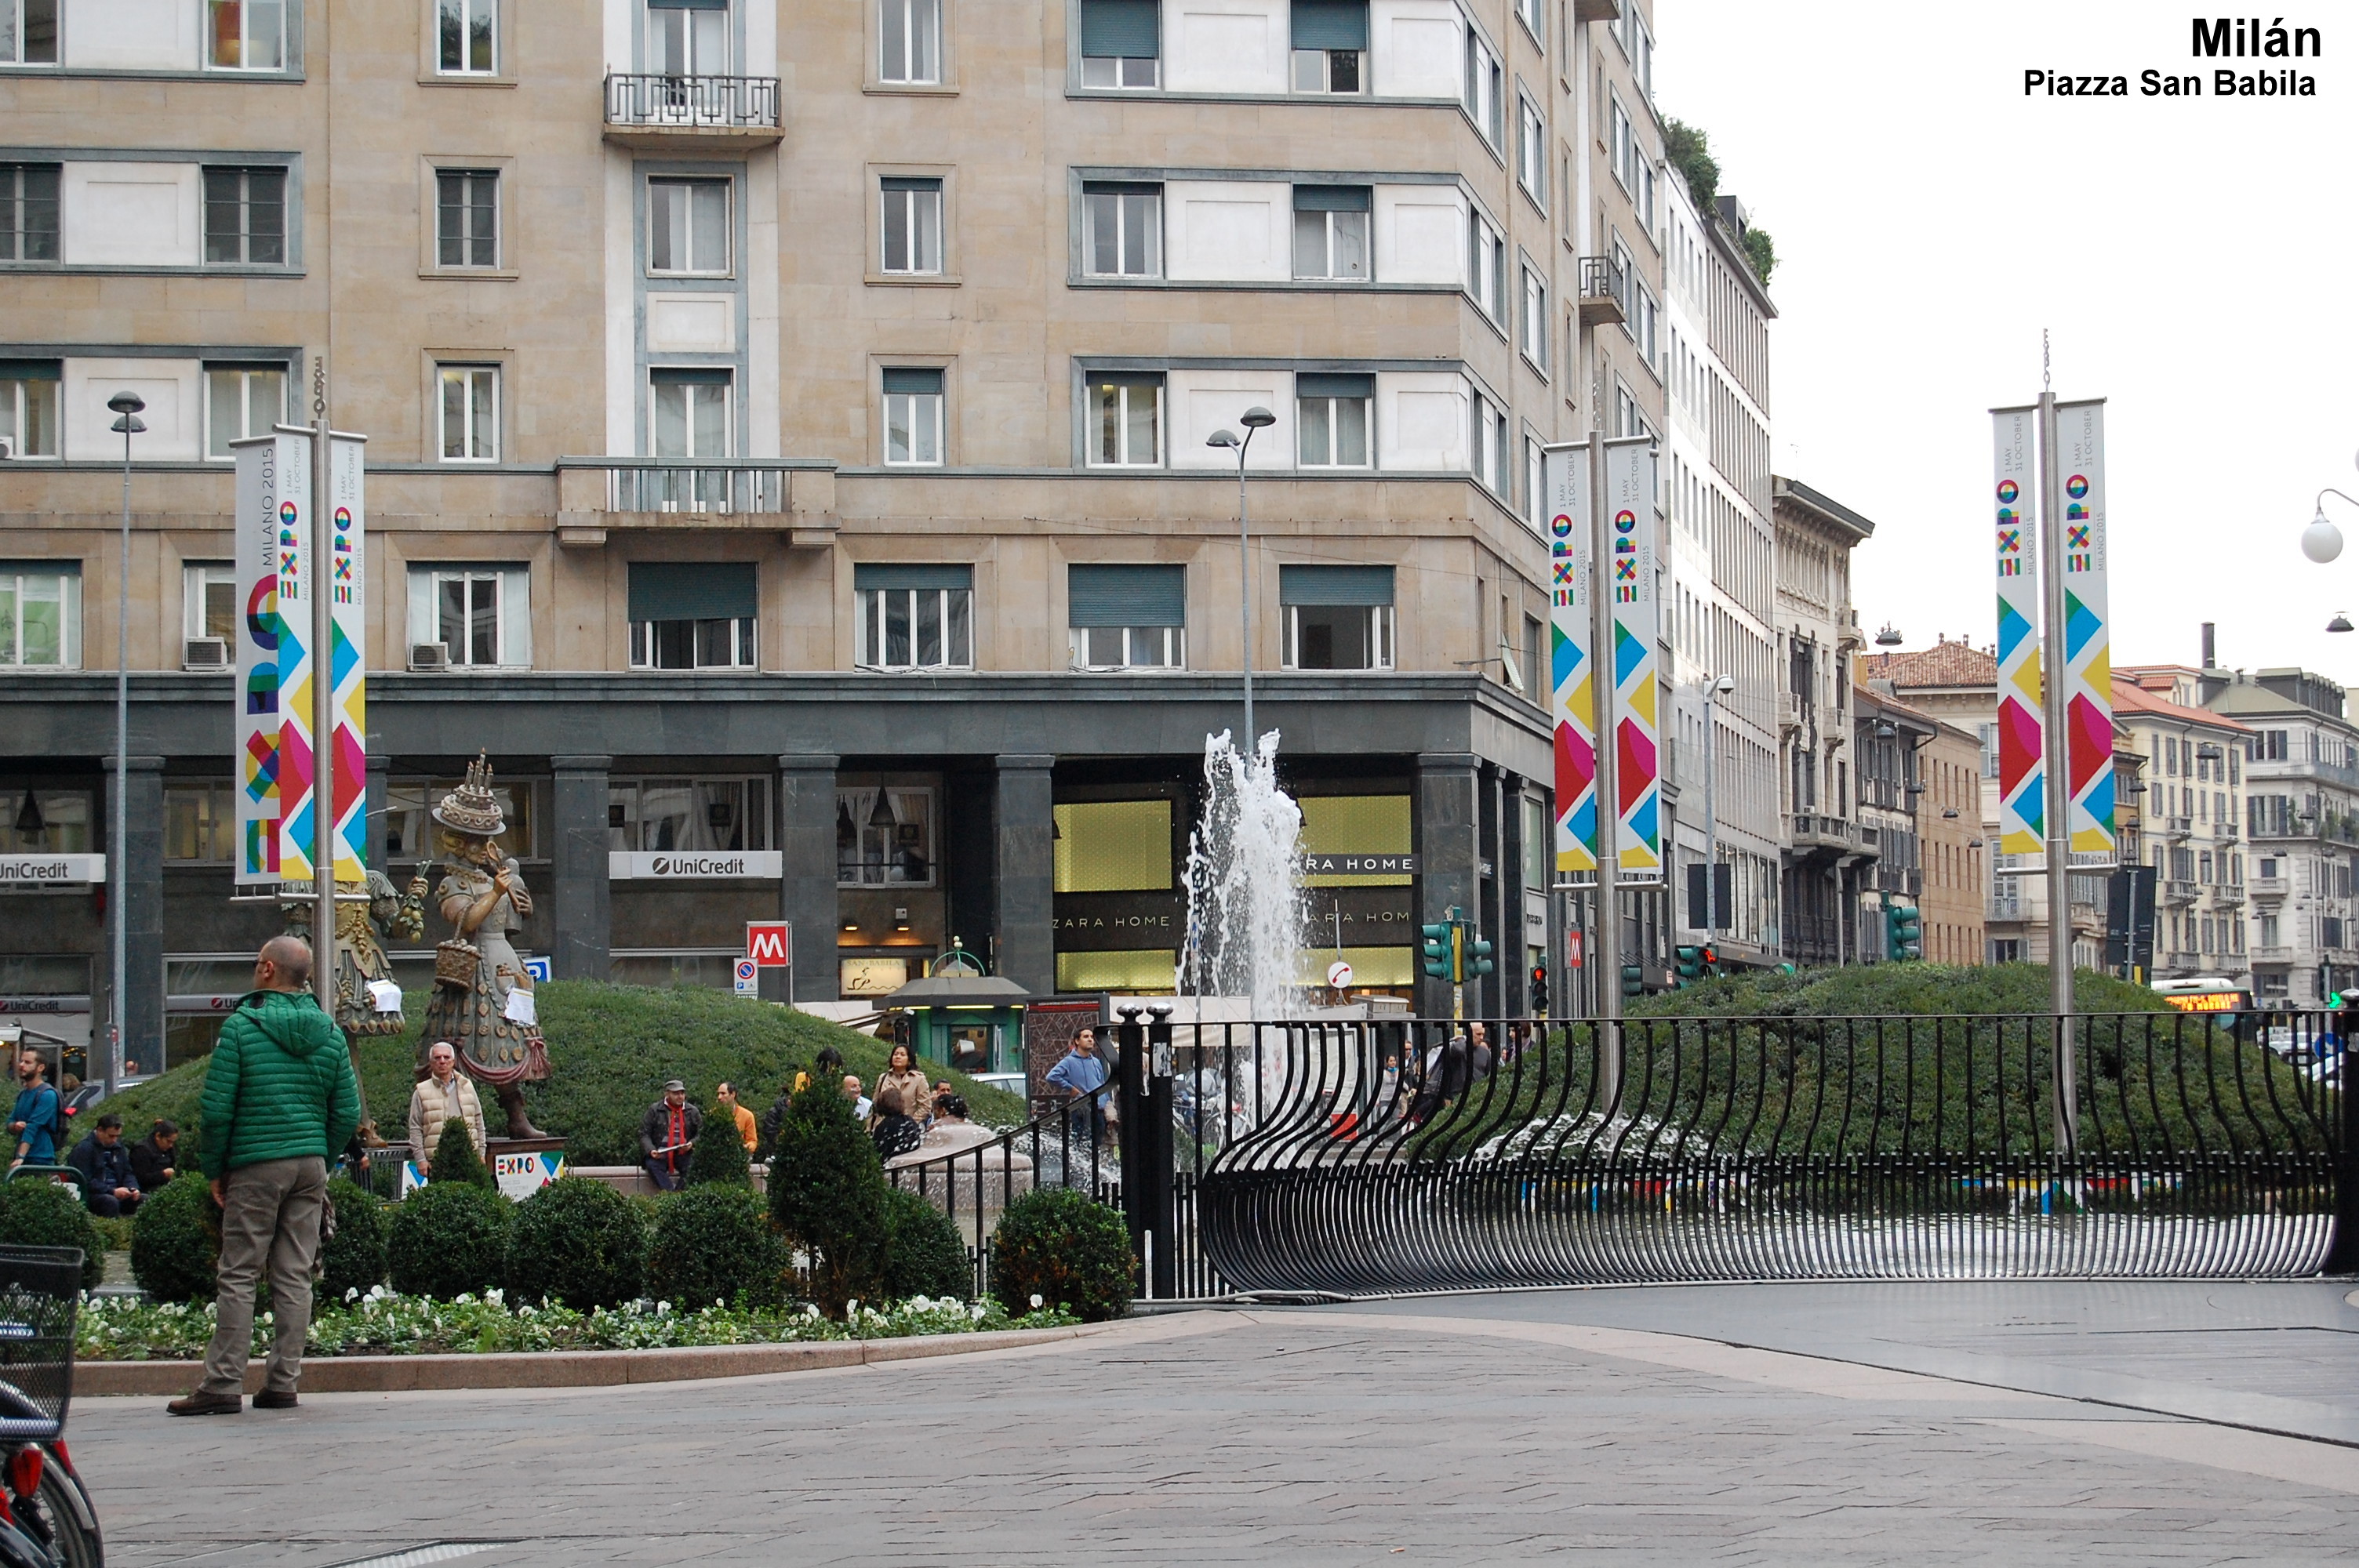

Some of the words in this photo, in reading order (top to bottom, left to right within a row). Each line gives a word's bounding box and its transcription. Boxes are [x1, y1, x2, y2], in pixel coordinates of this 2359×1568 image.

[263, 448, 273, 488] 2015
[2015, 462, 2022, 471] 31
[2085, 457, 2092, 466] 31
[349, 492, 354, 501] 31
[1569, 497, 1575, 506] 31
[1632, 492, 1639, 502] 31
[263, 495, 273, 566] MILANO
[1997, 479, 2020, 576] EXPO
[2066, 474, 2090, 572] EXPO
[280, 501, 297, 599] EXPO
[335, 506, 351, 604] EXPO
[1615, 510, 1637, 603] EXPO
[1552, 514, 1574, 606] EXPO
[673, 858, 744, 874] UniCredit
[1287, 858, 1334, 870] ARA
[1347, 858, 1413, 870] HOME
[1052, 917, 1103, 928] ZARA
[1115, 916, 1169, 927] HOME
[1309, 913, 1354, 923] ARA
[1366, 912, 1410, 922] HOM
[751, 933, 784, 958] M
[1571, 938, 1580, 960] M
[10, 1000, 59, 1011] UniCredit
[498, 1156, 535, 1175] EXPO
